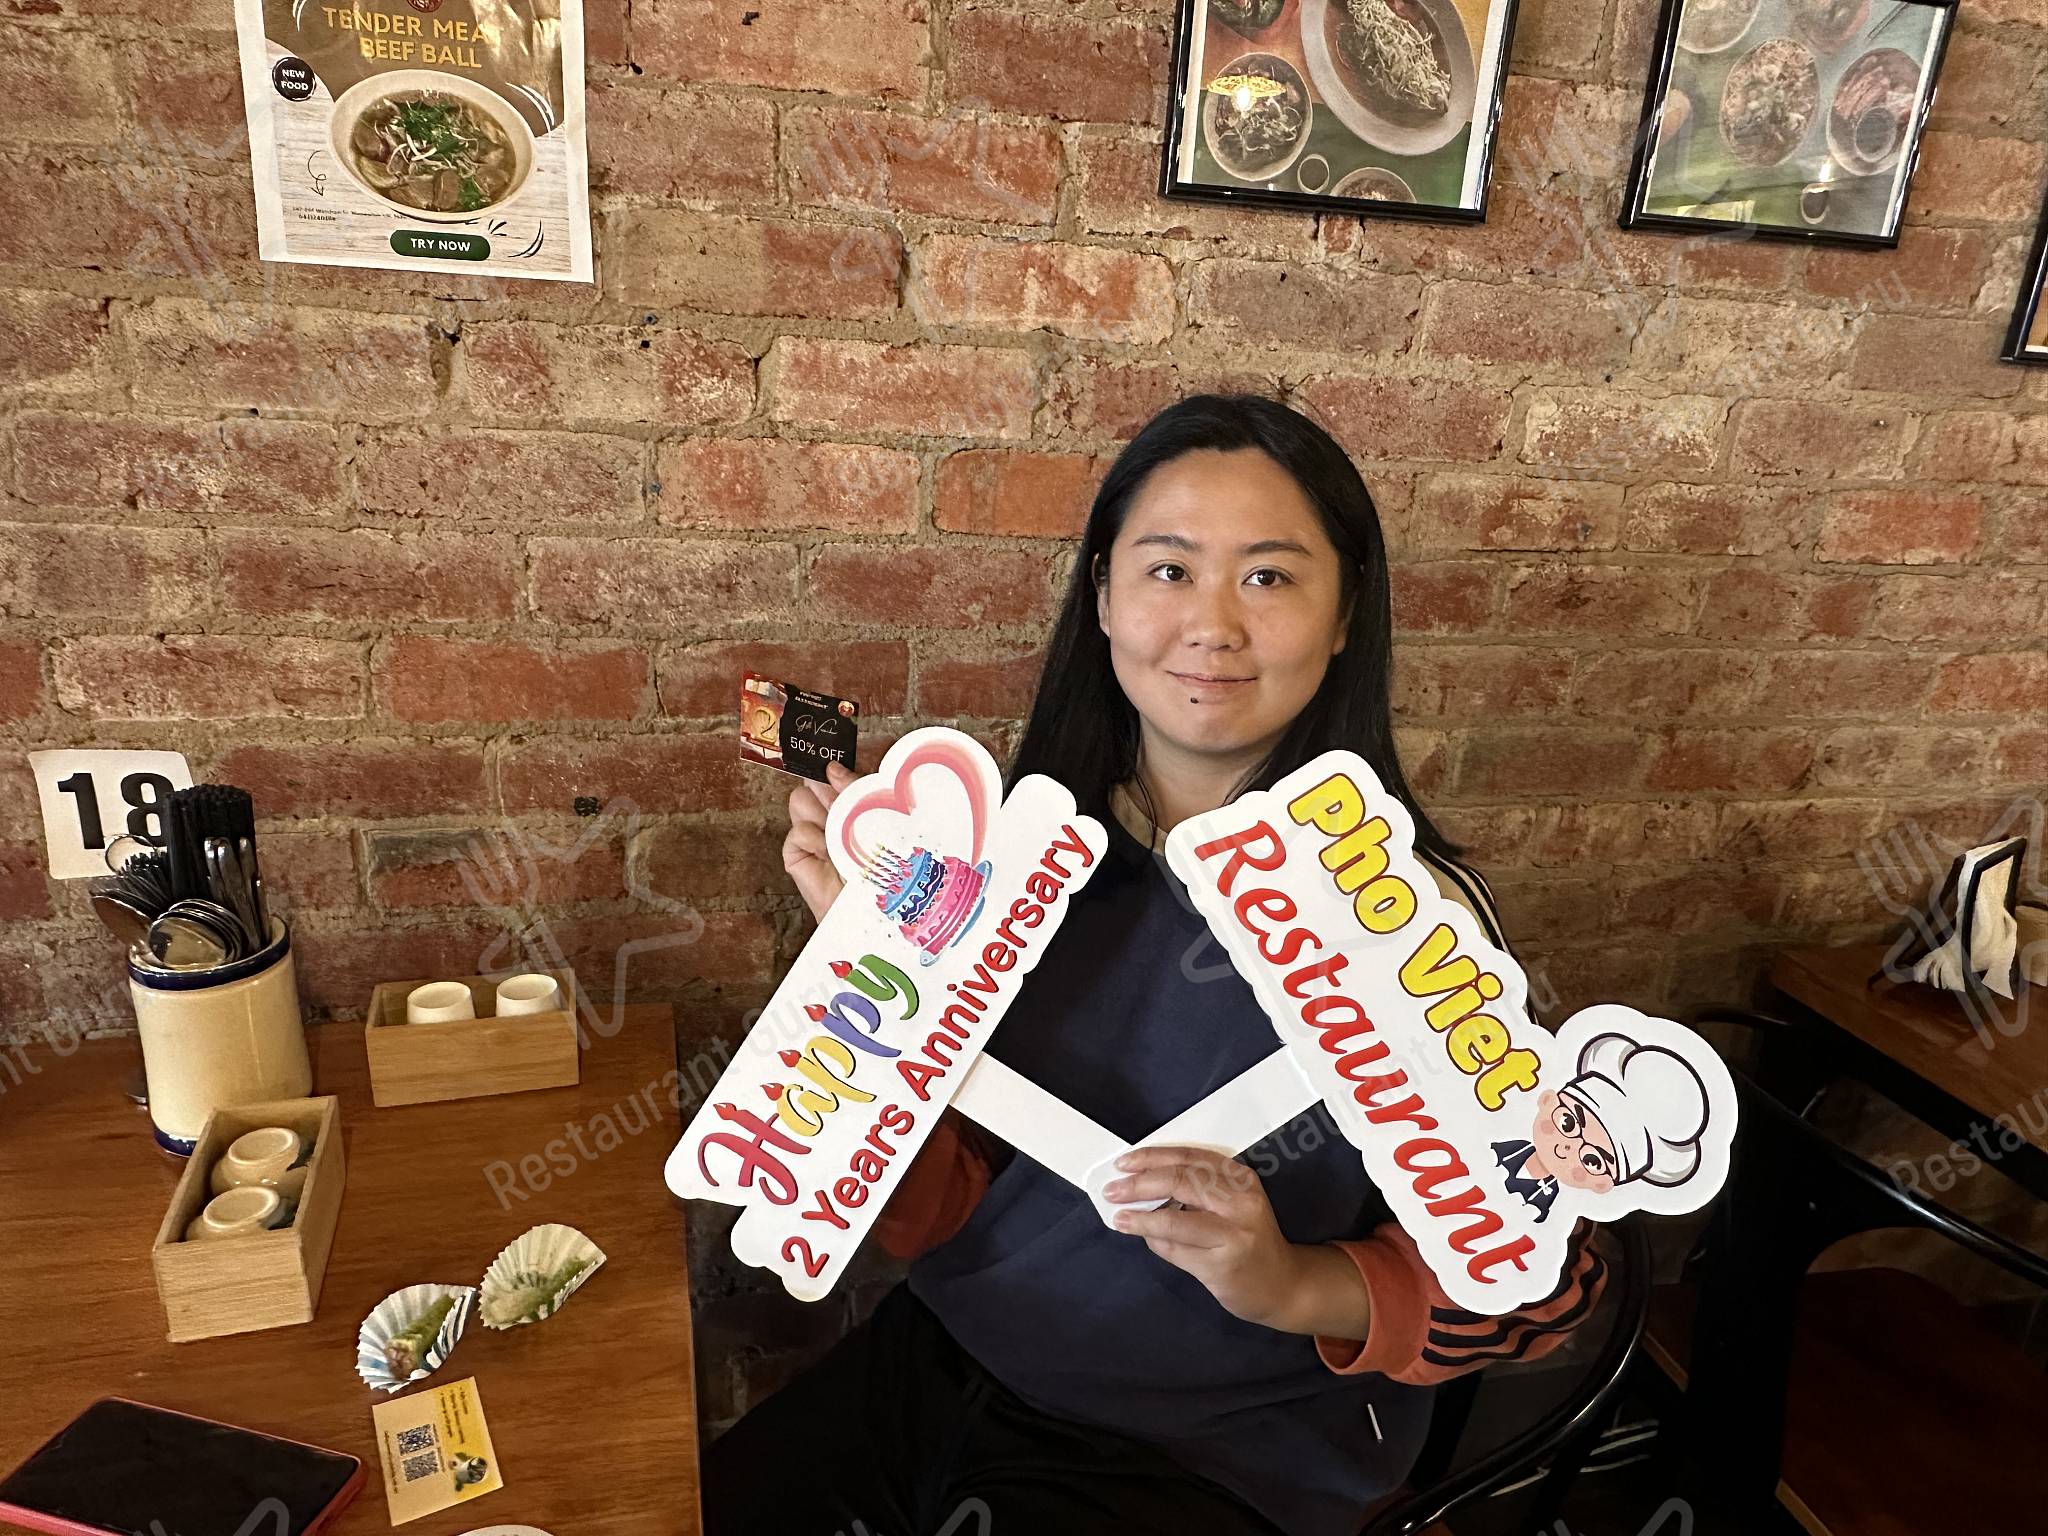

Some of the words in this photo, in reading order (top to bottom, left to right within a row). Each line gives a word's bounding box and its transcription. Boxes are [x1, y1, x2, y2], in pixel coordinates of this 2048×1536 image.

[322, 6, 424, 38] TENDER
[359, 37, 415, 62] BEEF
[421, 43, 482, 68] BALL
[281, 79, 309, 92] FOOD
[282, 68, 306, 80] NEW
[410, 237, 436, 251] TRY
[438, 239, 472, 253] NOW
[790, 736, 816, 756] 50%
[819, 746, 846, 761] OFF
[57, 772, 177, 850] 18
[896, 824, 1095, 1101] Anniversary
[1287, 773, 1418, 934] Pho
[1398, 923, 1541, 1112] Viet
[1194, 819, 1536, 1284] Restaurant
[699, 954, 919, 1206] Happy
[801, 1103, 915, 1230] Years
[781, 1236, 830, 1278] 2
